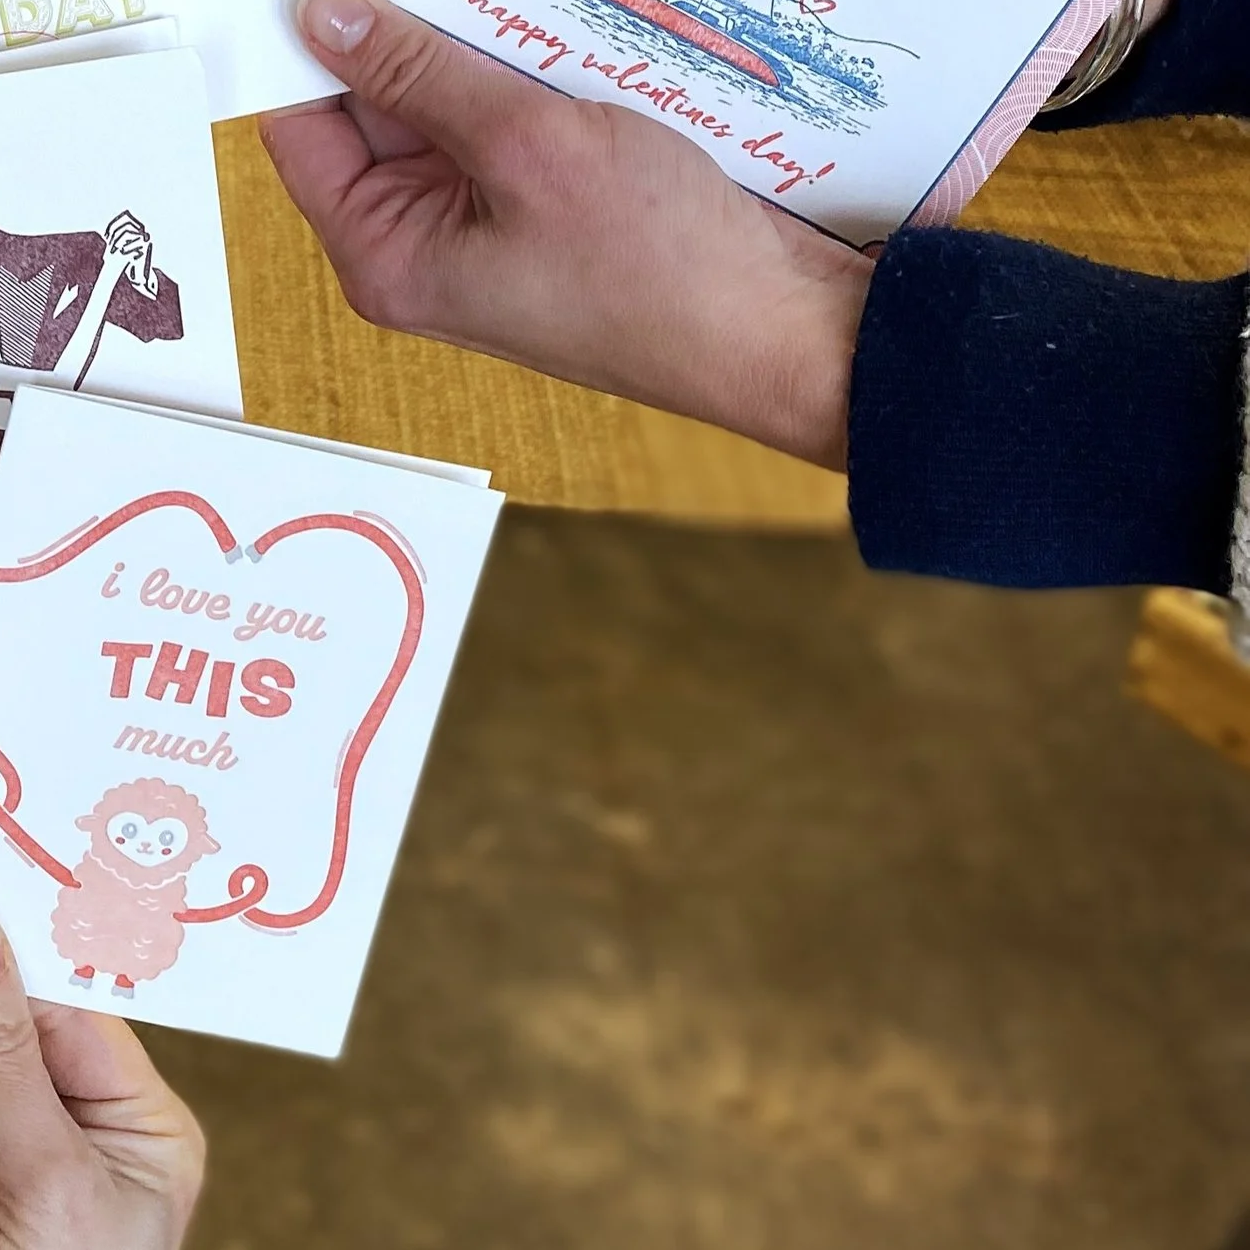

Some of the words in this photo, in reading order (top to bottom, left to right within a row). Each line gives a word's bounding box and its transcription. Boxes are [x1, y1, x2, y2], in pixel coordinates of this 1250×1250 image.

[581, 50, 734, 137] valentines
[740, 131, 836, 189] day!
[100, 561, 126, 599] i
[138, 568, 230, 619] love
[233, 602, 327, 643] you
[100, 640, 296, 719] THIS
[112, 722, 238, 771] much
